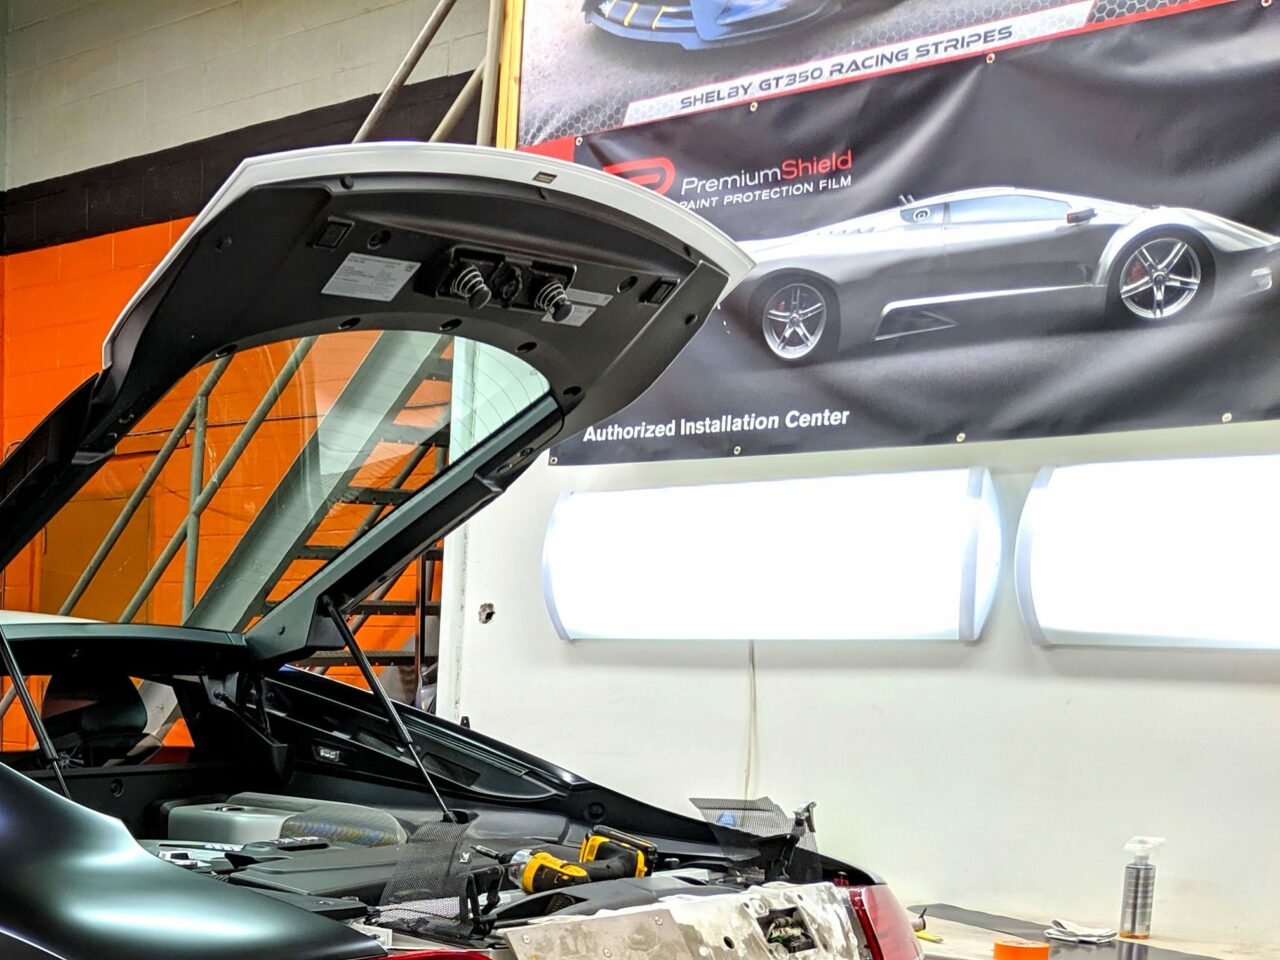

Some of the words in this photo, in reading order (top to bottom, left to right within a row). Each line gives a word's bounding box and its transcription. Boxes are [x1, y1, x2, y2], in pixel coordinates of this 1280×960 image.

[680, 82, 754, 110] SHELBY
[759, 67, 824, 92] GT350
[829, 48, 909, 76] RACING
[915, 25, 1013, 59] STRIPES
[681, 149, 853, 195] PremiumShield
[723, 181, 814, 206] PROTECTION
[819, 175, 852, 191] FILM
[583, 419, 676, 442] Authorized
[680, 413, 779, 436] Installation
[785, 409, 850, 428] Center
